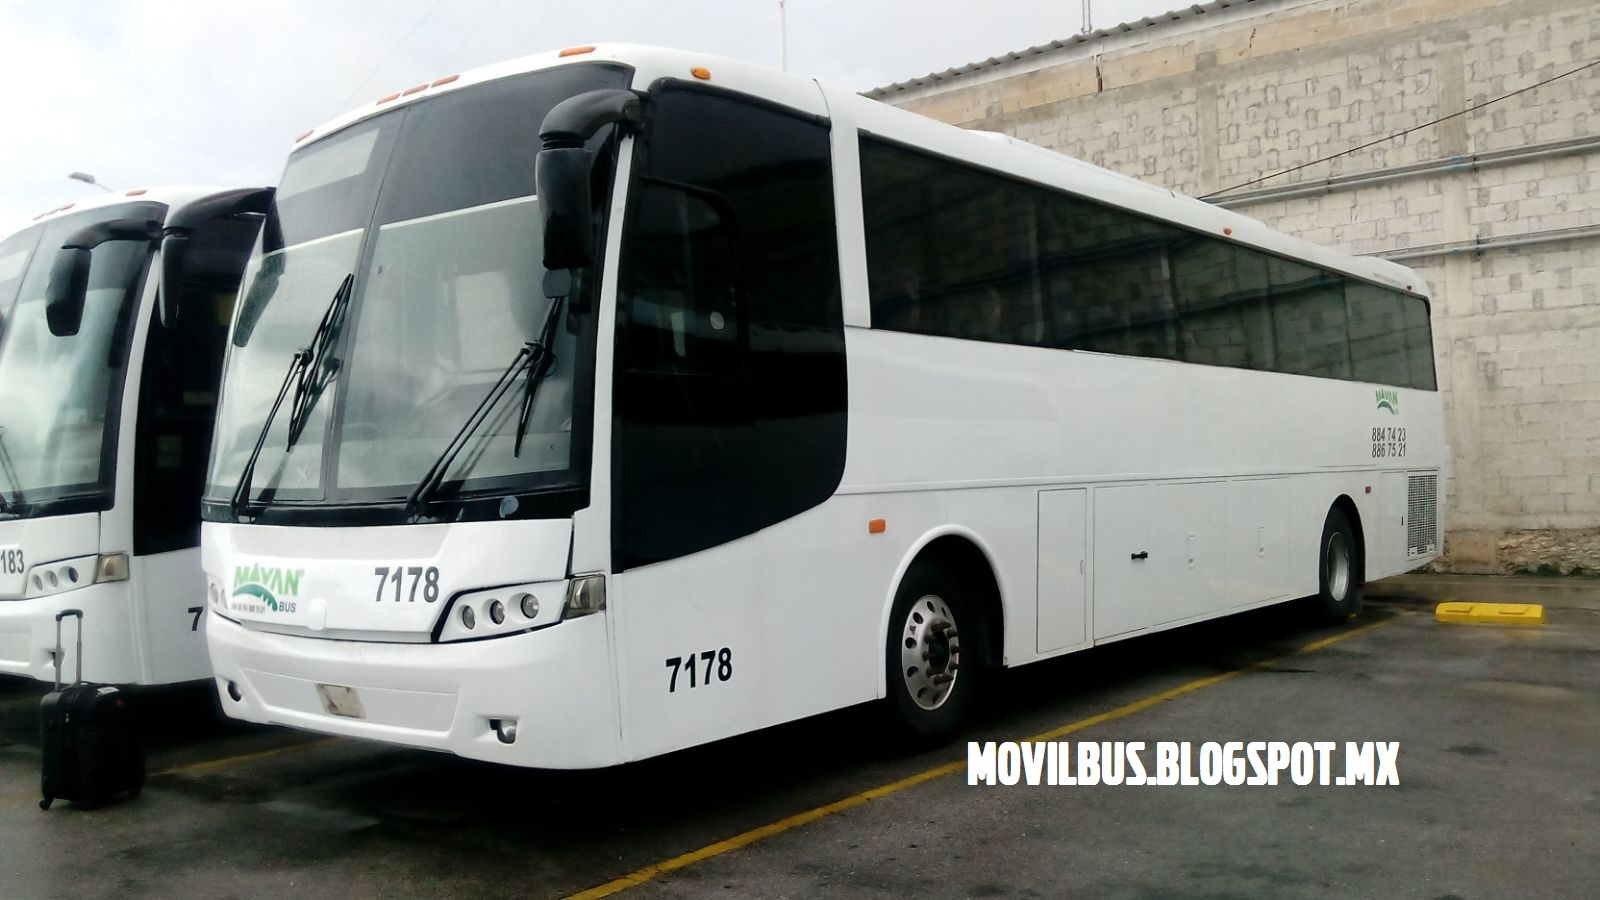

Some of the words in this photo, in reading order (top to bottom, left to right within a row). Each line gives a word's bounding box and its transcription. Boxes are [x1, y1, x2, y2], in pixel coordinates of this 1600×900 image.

[1372, 427, 1385, 442] 884
[1387, 427, 1396, 441] 74
[1398, 427, 1407, 442] 23
[1372, 443, 1386, 458] 886
[1387, 443, 1397, 457] 75
[1398, 443, 1407, 457] 21
[374, 566, 440, 603] 7178
[279, 601, 296, 613] BUS
[665, 647, 732, 693] 7178
